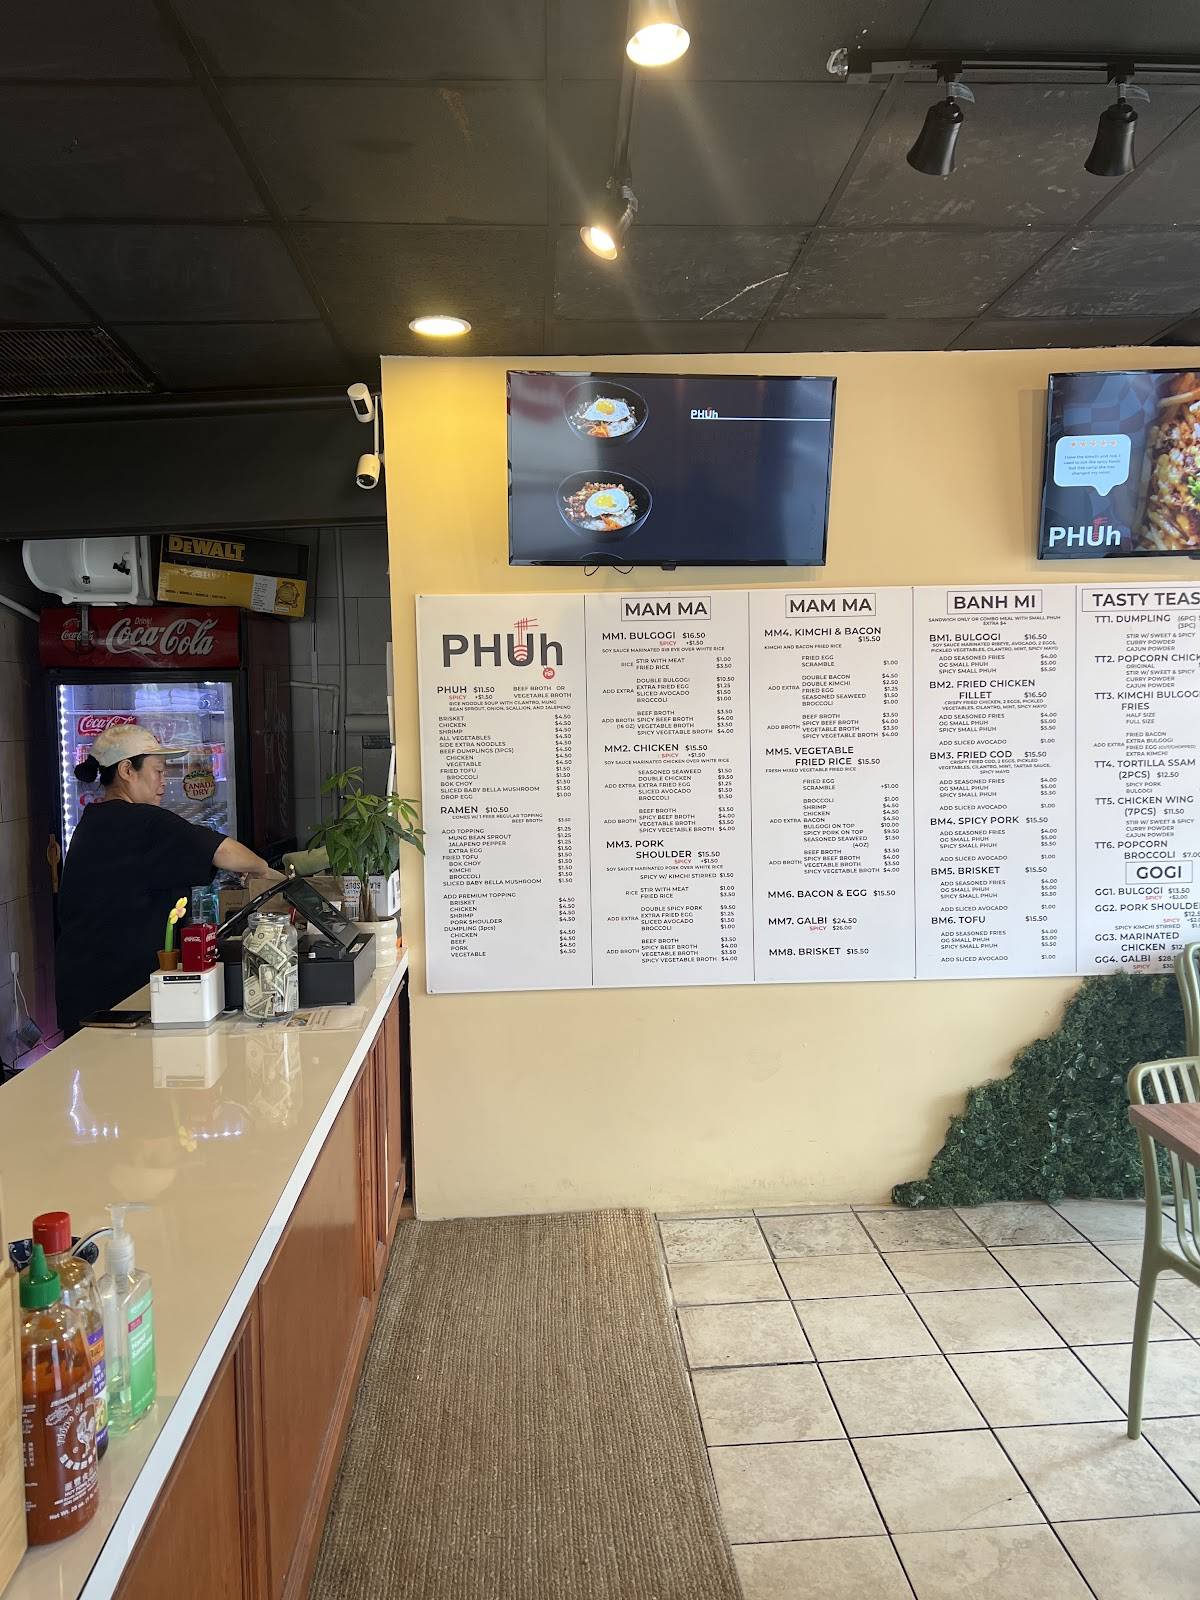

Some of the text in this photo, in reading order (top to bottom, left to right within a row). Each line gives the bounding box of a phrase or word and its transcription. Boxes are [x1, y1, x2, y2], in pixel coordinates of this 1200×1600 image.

[690, 409, 719, 419] PHUh
[1049, 526, 1121, 547] PHUh
[954, 595, 1035, 609] BANH MI
[1092, 593, 1149, 606] TASTY
[626, 602, 708, 616] MAM MA
[790, 598, 872, 613] MAM MA
[1116, 614, 1170, 623] DUMPLING
[61, 630, 95, 641] Coca-Ca
[602, 632, 626, 640] MM1.
[630, 631, 675, 640] BULGOGI
[765, 629, 792, 637] MM4.
[795, 628, 831, 636] KIMCHI
[845, 627, 881, 635] BACON
[106, 618, 219, 656] Coca-Cola
[930, 634, 952, 642] BM1.
[955, 633, 1000, 641] BULGOGI
[442, 633, 563, 667] PHUh
[1094, 655, 1115, 663] TT2.
[1118, 654, 1168, 662] POPCORN
[957, 680, 987, 688] FRIED
[990, 679, 1035, 687] CHICKEN
[437, 686, 467, 694] PHUH
[959, 691, 992, 699] FILLET
[1094, 692, 1114, 700] TT3.
[1117, 691, 1153, 699] KIMCHI
[1122, 702, 1150, 710] FRIES
[633, 744, 678, 752] CHICKEN
[794, 746, 854, 755] VEGETABLE
[930, 752, 954, 760] BM3.
[957, 751, 987, 759] FRIED
[990, 750, 1012, 758] COD
[795, 758, 825, 766] FRIED
[829, 757, 852, 765] RICE
[1117, 759, 1165, 768] TORTILLA
[1119, 771, 1150, 780] (2PCS)
[192, 788, 210, 797] DRY
[1095, 797, 1115, 805] TT5.
[1117, 796, 1162, 804] CHICKEN
[440, 806, 478, 814] RAMEN
[1125, 807, 1156, 817] (7PCS)
[958, 817, 988, 825] SPICY
[990, 816, 1019, 824] PORK
[1094, 840, 1167, 849] TT6. POPCORN
[636, 850, 691, 859] SHOULDER
[1124, 851, 1175, 859] BROCCOLI
[958, 866, 1000, 874] BRISKET
[1136, 866, 1181, 879] GOGI
[797, 890, 833, 898] BACON
[1095, 888, 1115, 896] GG1.
[1118, 887, 1163, 895] BULGOGI
[1095, 904, 1117, 912] GG2.
[1151, 902, 1200, 910] SHOULDE
[797, 917, 827, 925] GALBI
[932, 916, 956, 924] BM6.
[1120, 932, 1179, 940] MARINATED
[769, 948, 796, 956] MM8.
[799, 947, 841, 955] BRISKET
[1121, 943, 1165, 951] CHICKEN
[1121, 955, 1150, 963] GALBI
